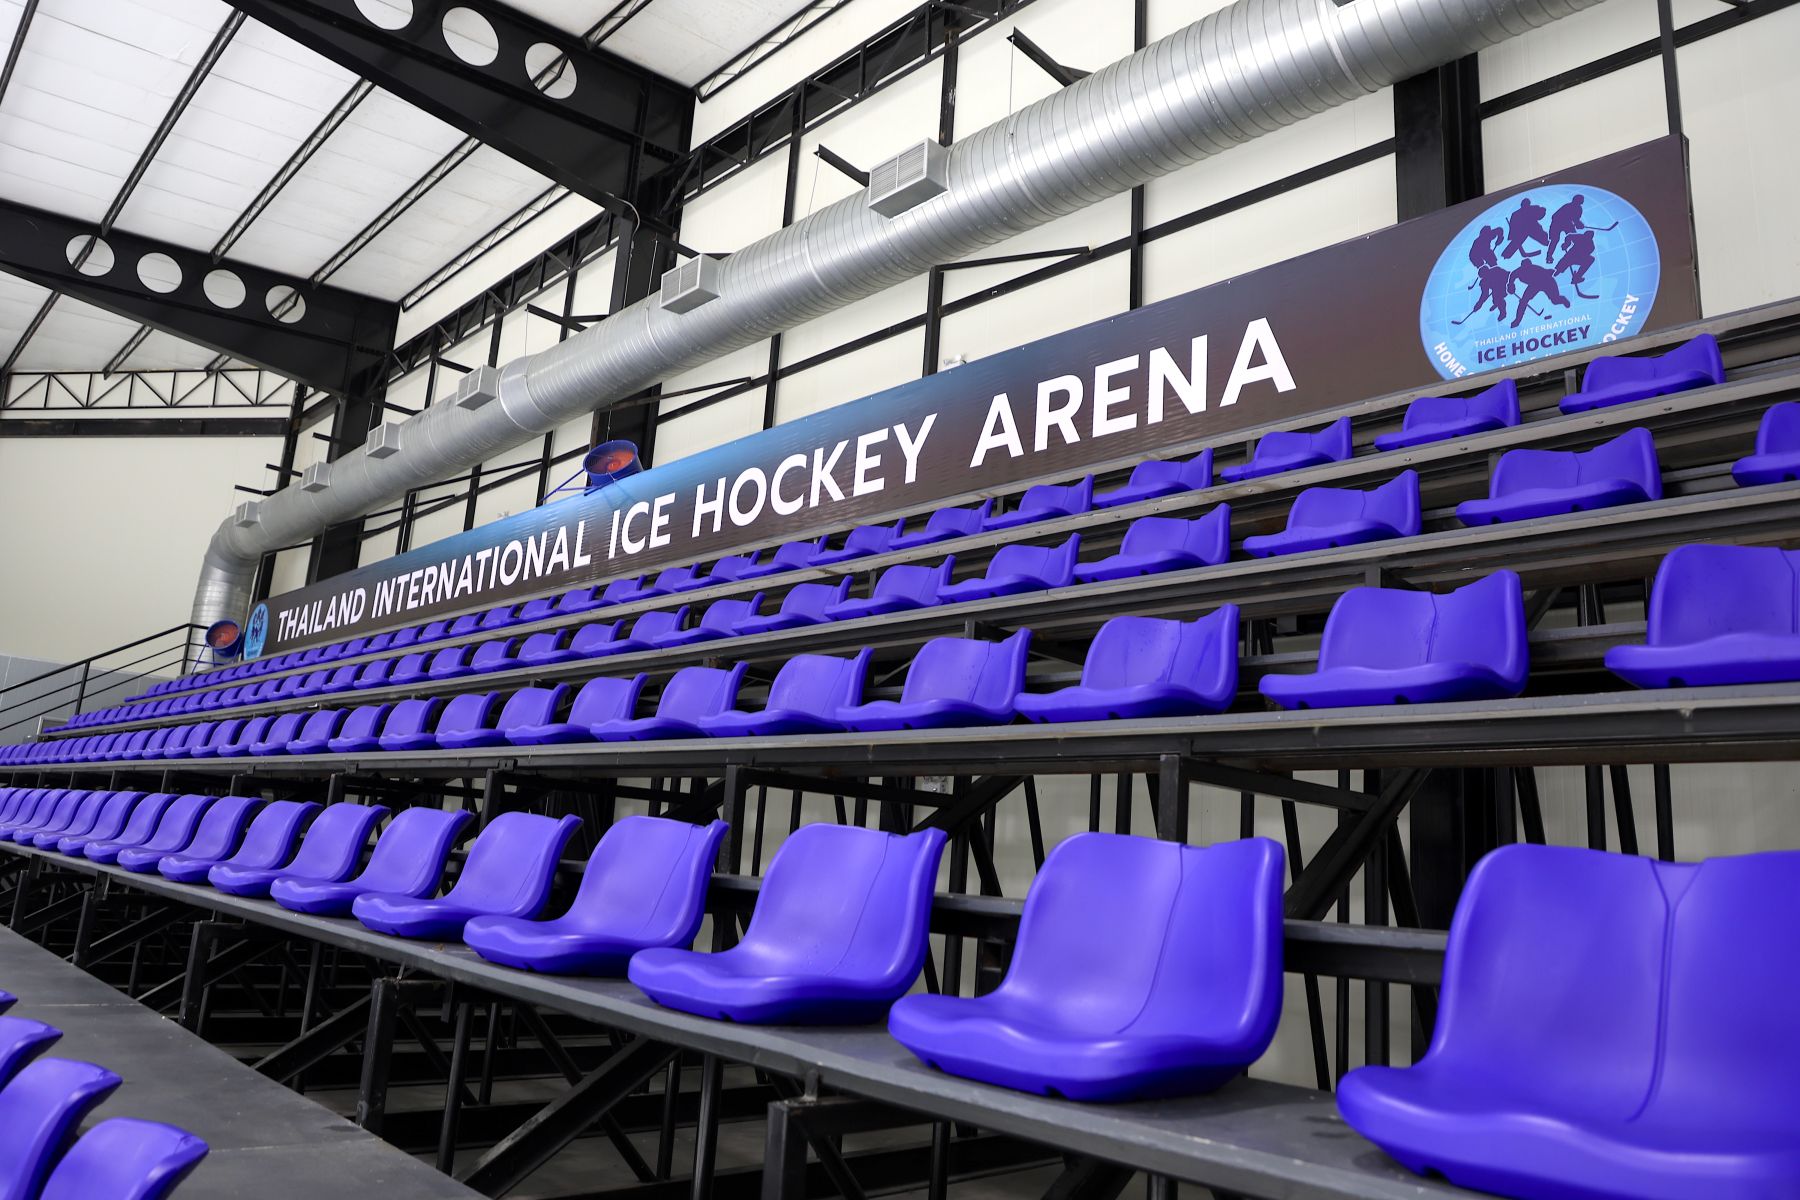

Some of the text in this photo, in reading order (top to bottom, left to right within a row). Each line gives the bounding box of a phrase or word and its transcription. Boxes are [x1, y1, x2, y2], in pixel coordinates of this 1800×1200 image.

[1434, 341, 1467, 379] HOME
[1599, 293, 1640, 344] OCKEY
[1474, 313, 1593, 348] THAILAND INTERNATIONAL
[1477, 344, 1507, 365] ICE
[1511, 324, 1591, 357] HOCKEY
[277, 317, 1297, 642] THAILAND INTERNATIONAL ICE HOCKEY ARENA
